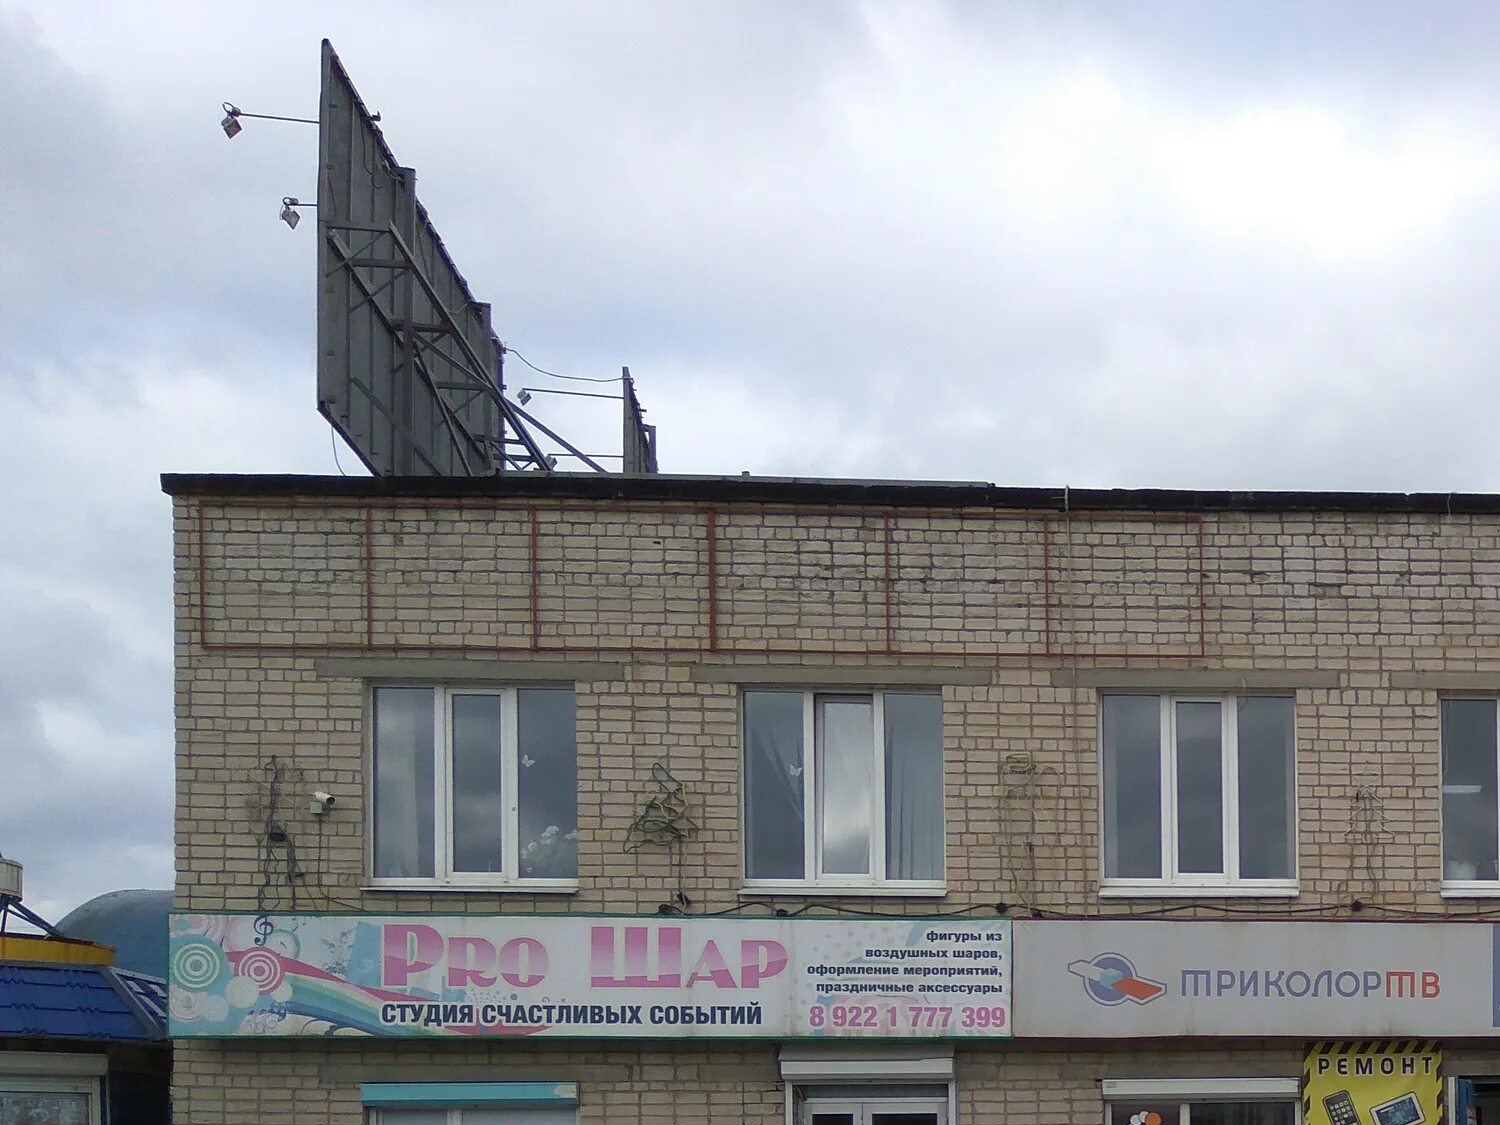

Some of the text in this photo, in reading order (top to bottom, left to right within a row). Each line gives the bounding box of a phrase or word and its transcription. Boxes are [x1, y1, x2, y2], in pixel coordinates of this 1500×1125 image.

[926, 930, 1002, 943] фигуры из
[865, 949, 1003, 961] воздушных шаров,
[807, 964, 1003, 977] оформление мероприятий,
[816, 983, 1003, 994] праздничные аксессуары
[381, 1001, 762, 1027] СТУДИЯ СЧАСТЛИВЫХ СОБЫТИЙ
[809, 1006, 1006, 1028] 8 922 1 777 399
[1318, 1056, 1433, 1075] РЕМОНТ
